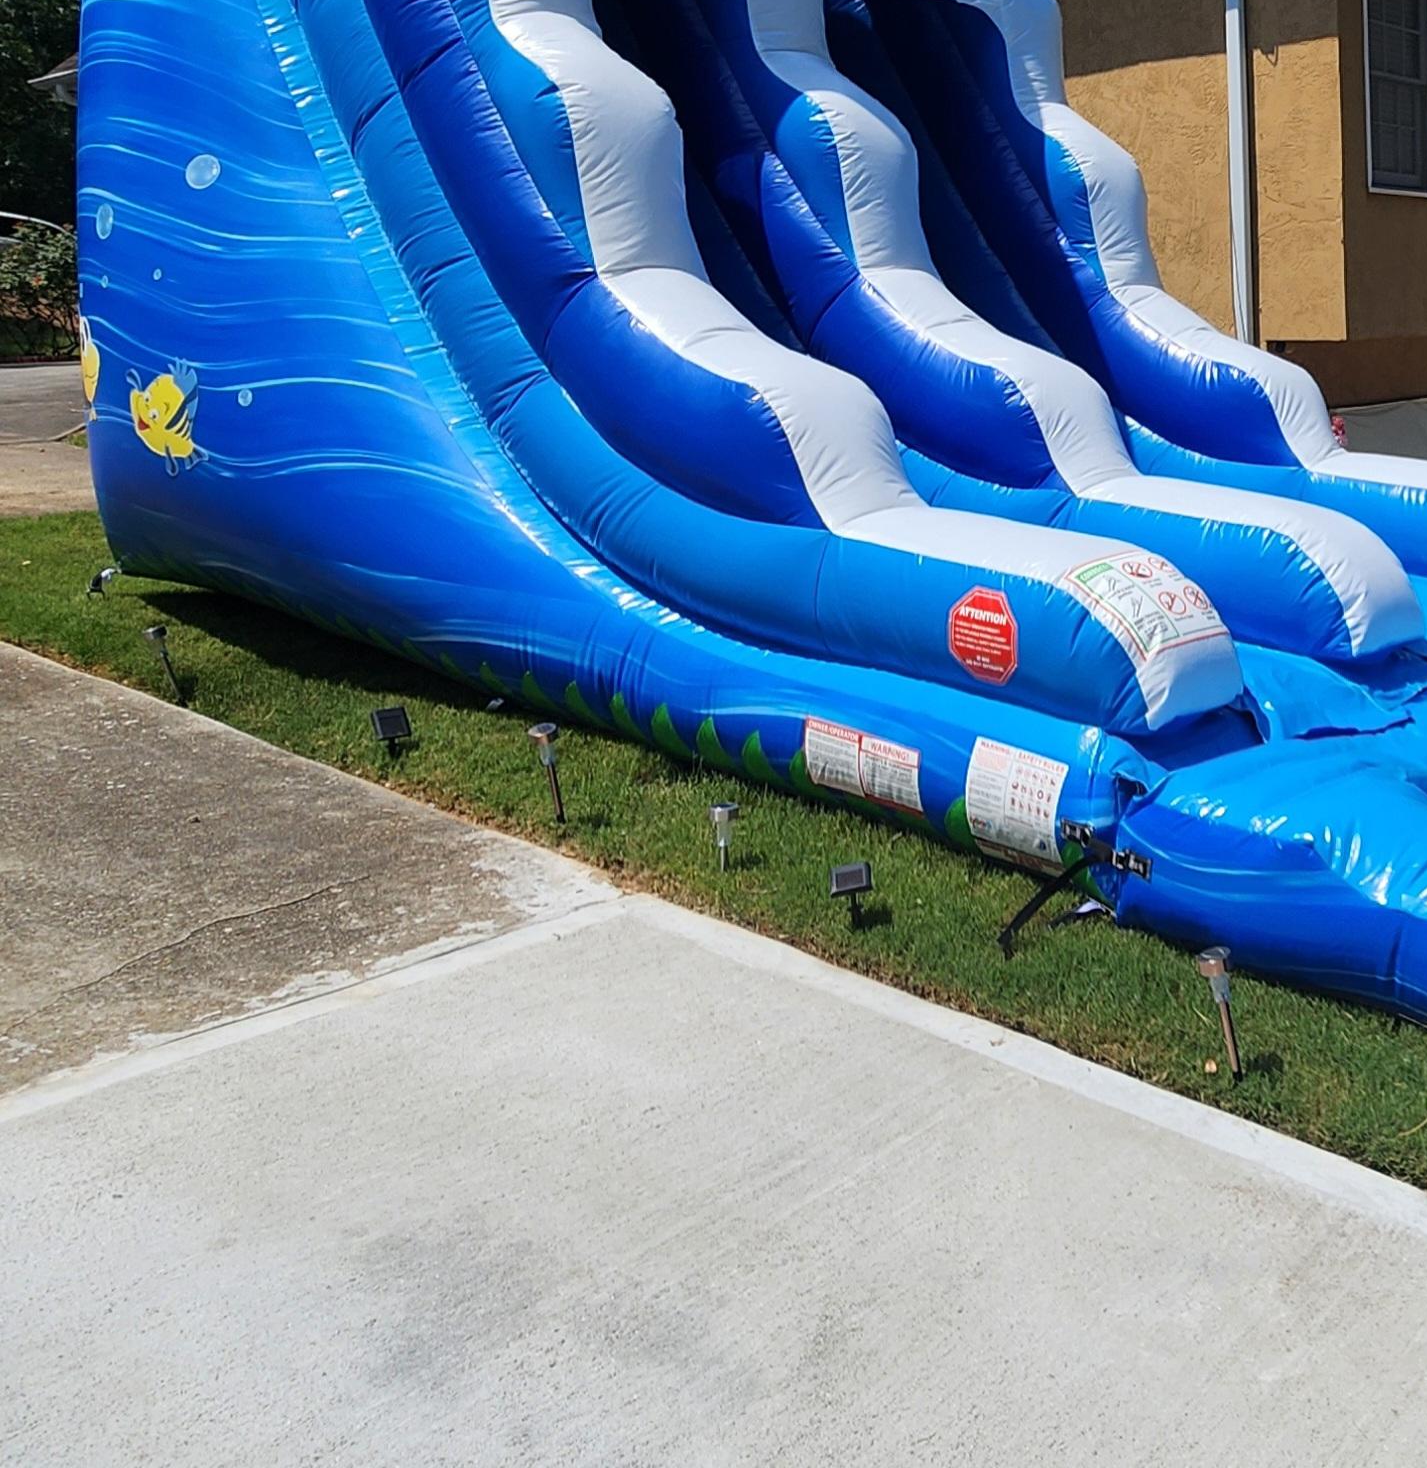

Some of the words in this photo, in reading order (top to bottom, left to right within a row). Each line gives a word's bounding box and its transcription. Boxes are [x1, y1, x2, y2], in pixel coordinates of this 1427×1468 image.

[959, 606, 1007, 626] ATTENTION
[808, 720, 859, 741] OWNER/OPERATOR
[870, 741, 910, 761] WARNING!
